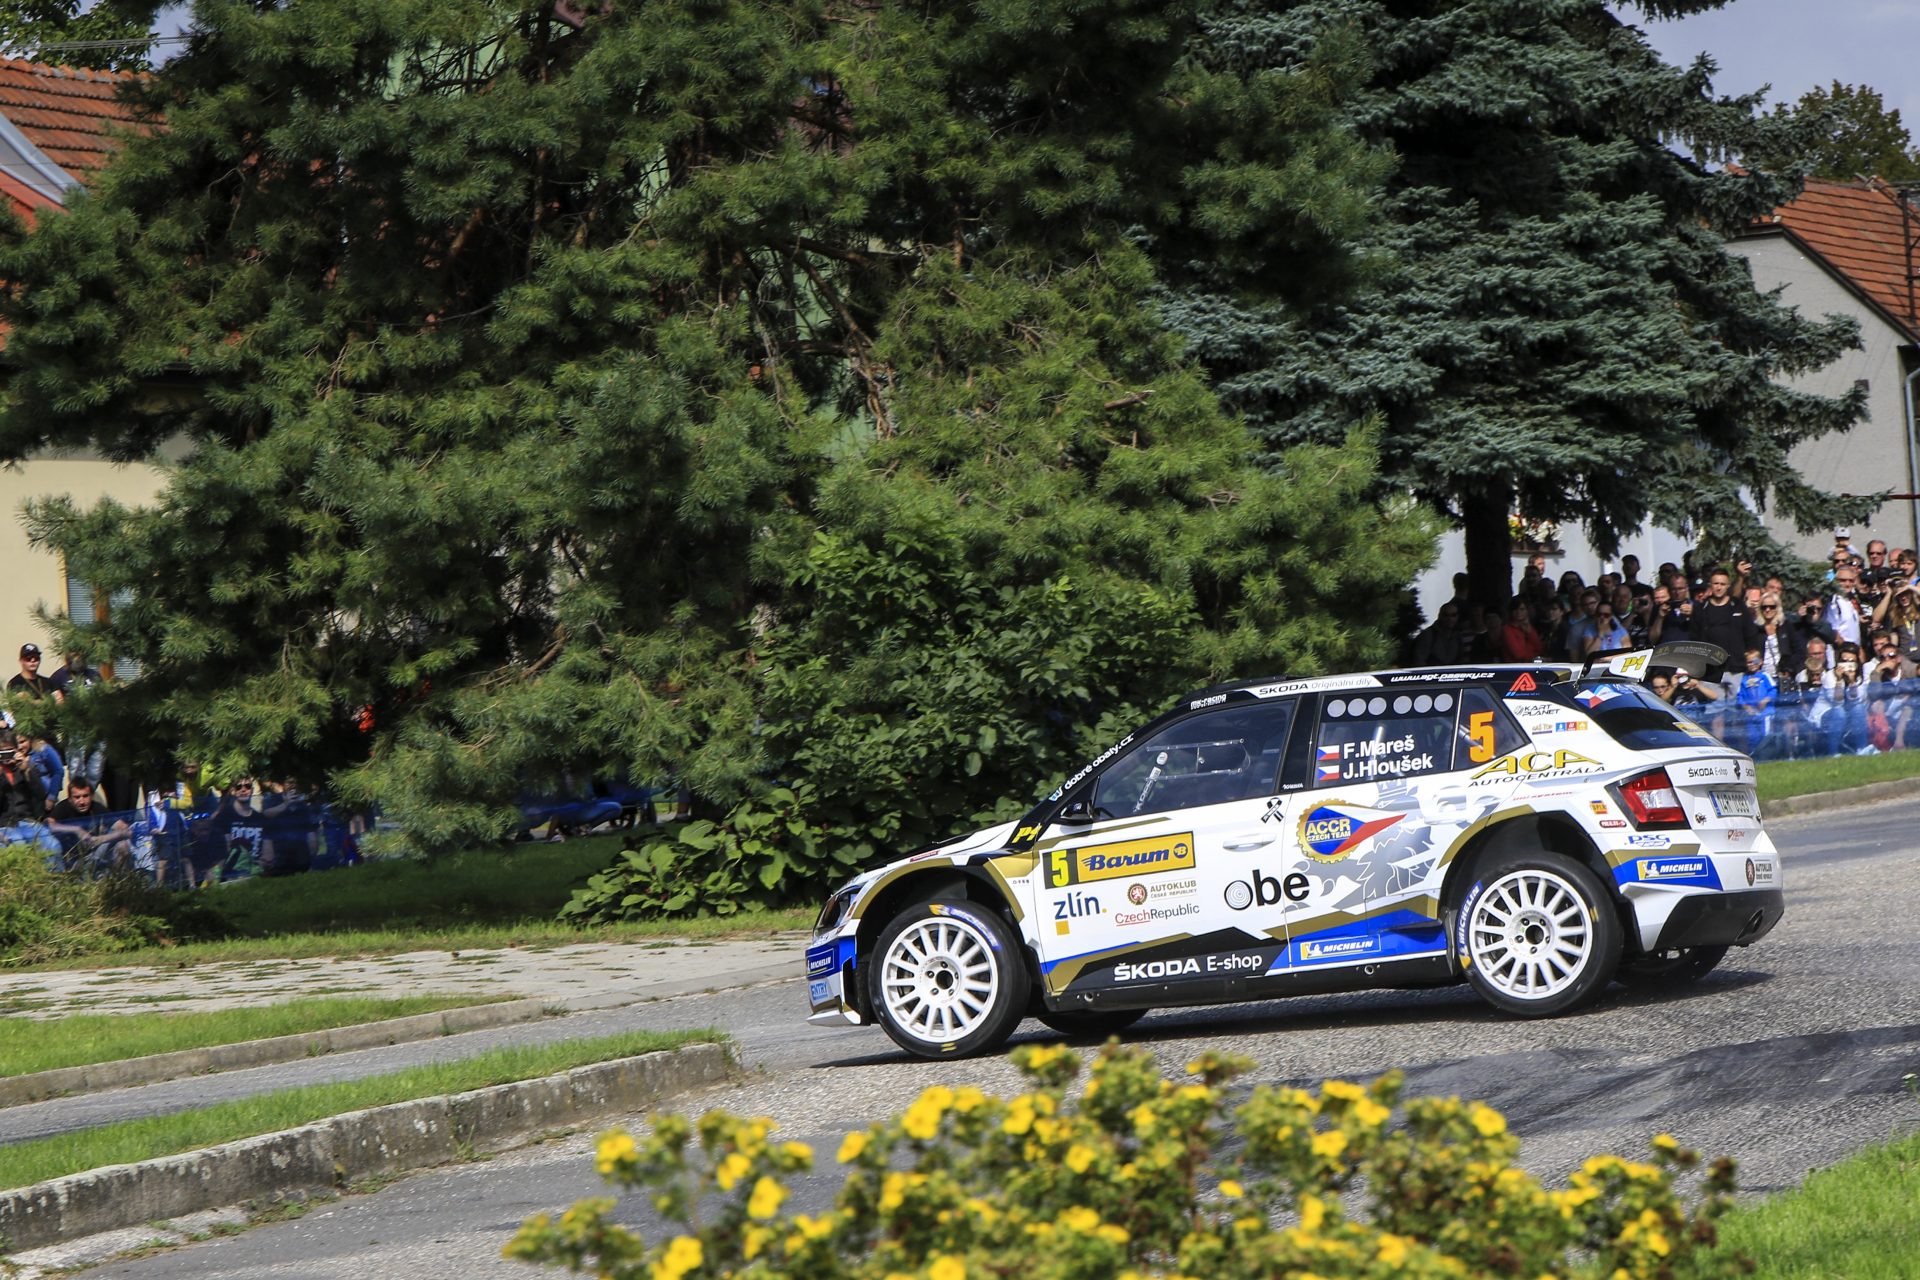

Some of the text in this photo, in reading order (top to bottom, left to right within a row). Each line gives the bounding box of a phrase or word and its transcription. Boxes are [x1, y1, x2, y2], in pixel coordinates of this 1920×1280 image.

[1522, 708, 1561, 717] PLANET
[1524, 703, 1552, 712] KART
[1469, 711, 1495, 763] 5
[1343, 735, 1415, 760] F.Mareš
[1343, 754, 1433, 780] J.Hloušek
[1470, 749, 1603, 780] ACA
[1688, 767, 1715, 778] ŠKODA
[1468, 765, 1606, 788] AUTOCENTRÁLA
[1306, 818, 1351, 836] ACCR
[1306, 830, 1351, 842] CZECH TEAM
[1051, 849, 1070, 888] 5
[1086, 848, 1169, 871] Barum
[1660, 863, 1703, 873] MICHELIN
[1150, 880, 1197, 892] AUTOKLUB
[1459, 885, 1480, 944] MICHELIN
[1323, 940, 1373, 953] MICHELIN
[811, 956, 831, 970] MICHELIN
[1114, 953, 1263, 982] ŠKODA E-shop
